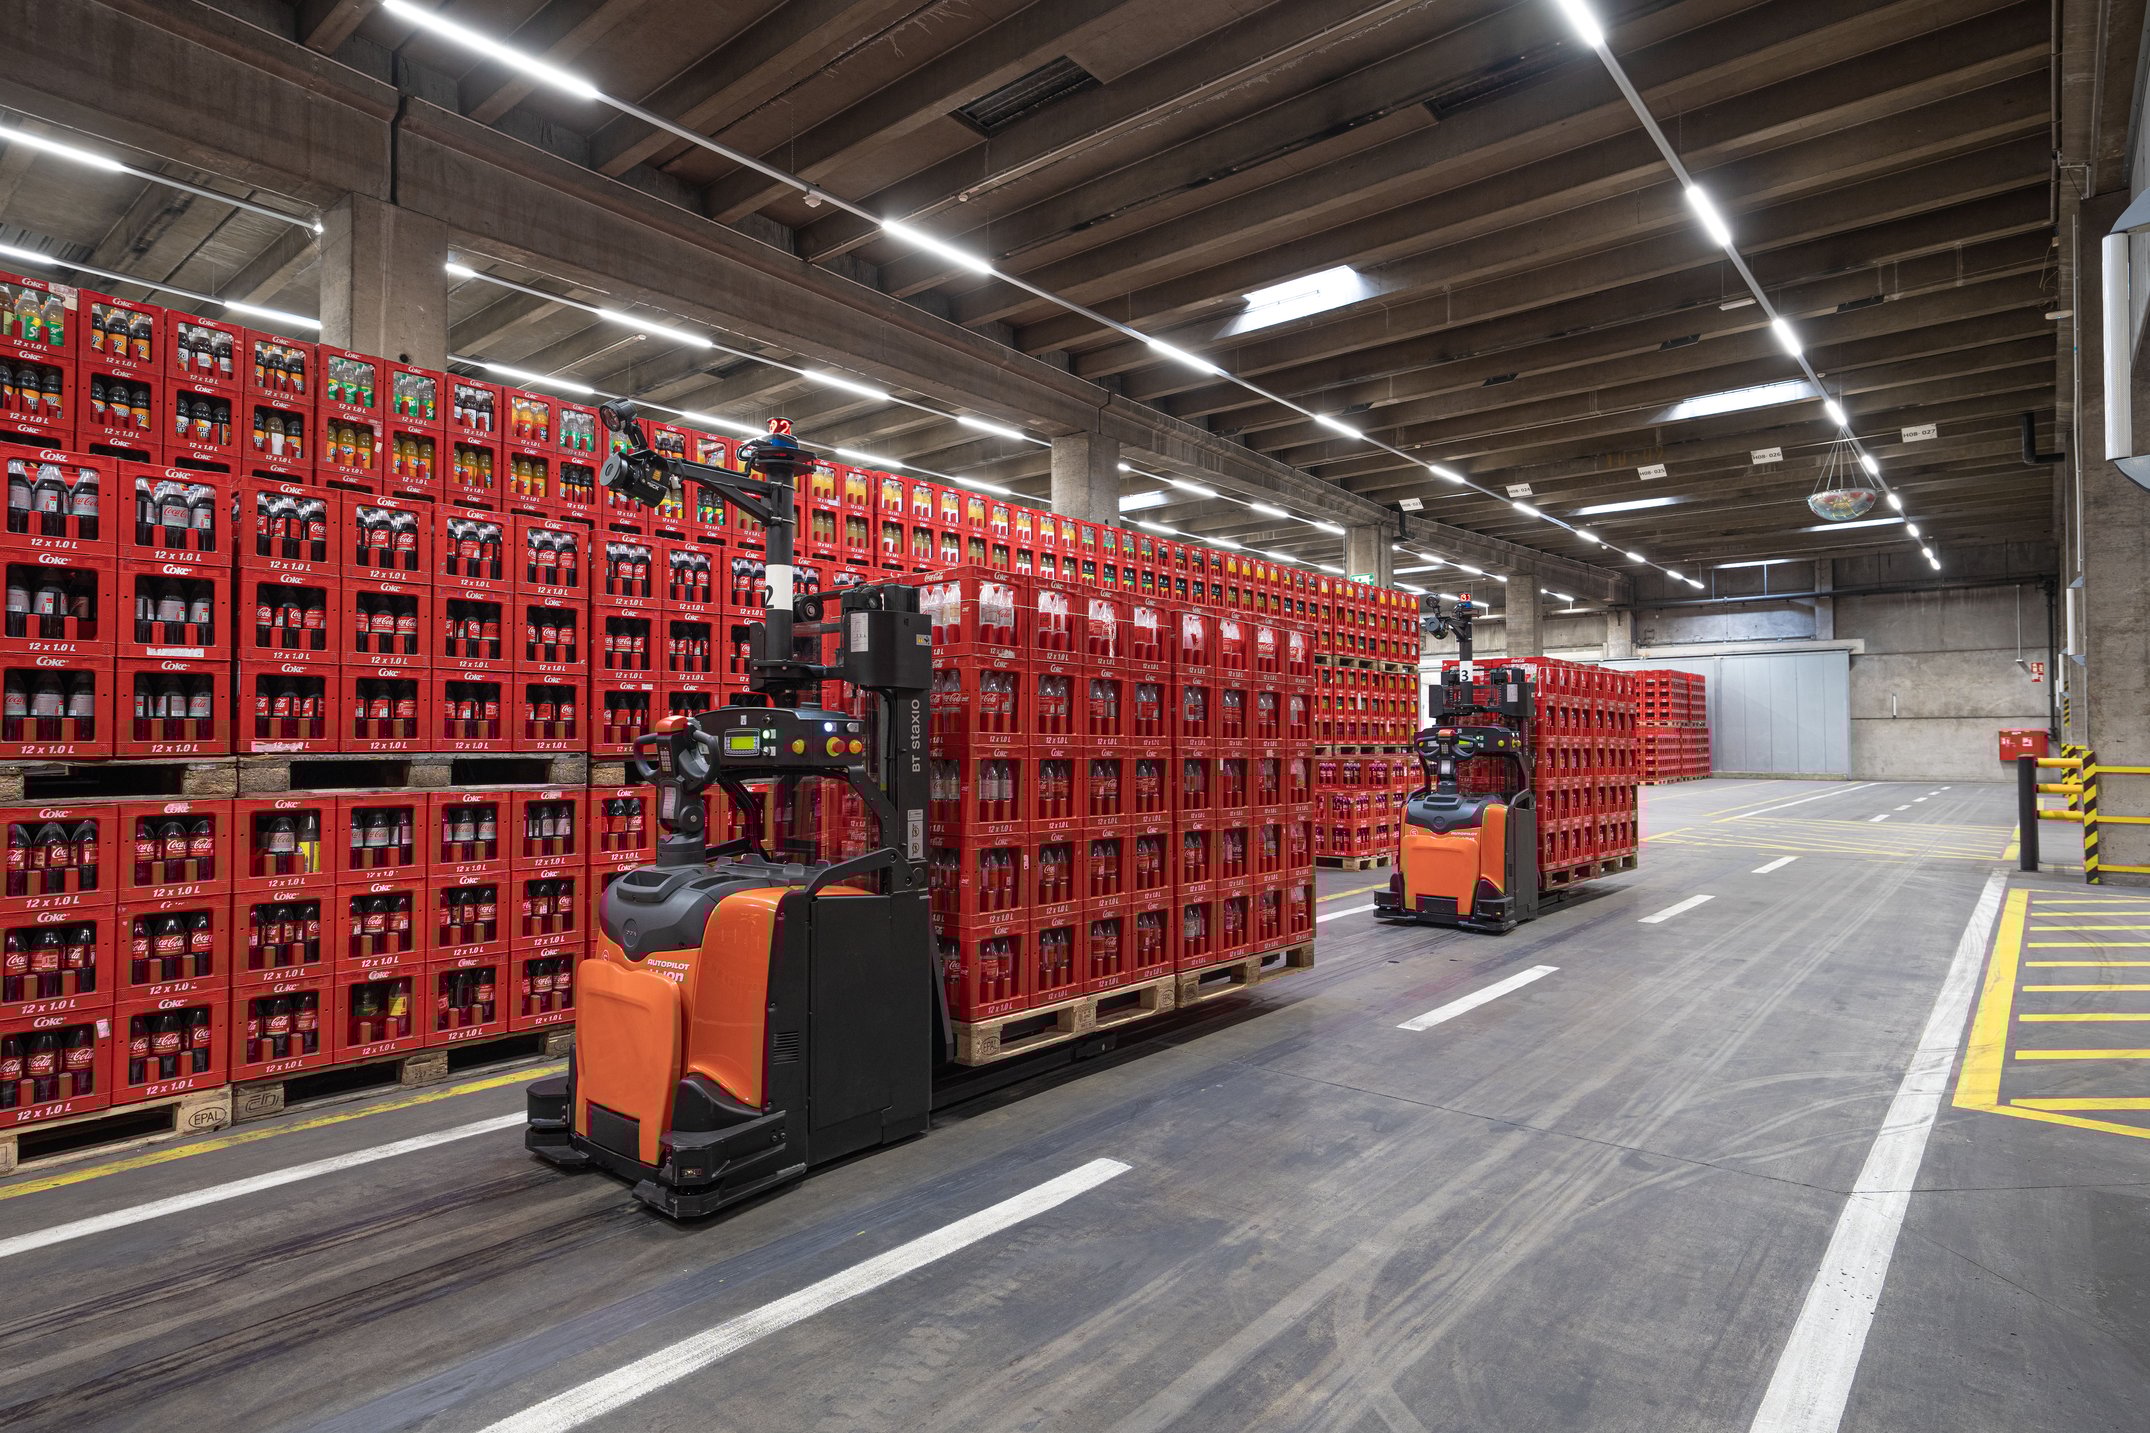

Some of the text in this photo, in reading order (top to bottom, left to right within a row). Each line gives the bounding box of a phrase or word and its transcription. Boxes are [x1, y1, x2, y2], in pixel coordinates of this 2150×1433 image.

[22, 278, 45, 288] Coke
[113, 298, 134, 307] Coke
[198, 318, 218, 327] Coke
[19, 351, 42, 360] Coke
[112, 369, 133, 378] Coke
[195, 385, 214, 393] Coke
[18, 424, 41, 433] Coke
[110, 438, 130, 447] Coke
[40, 450, 68, 462] Coke
[165, 468, 193, 479] Coke
[280, 484, 305, 494] Coke
[377, 497, 399, 507] Coke
[467, 510, 487, 520] Coke
[32, 538, 42, 546] 12
[56, 540, 70, 548] 1.0
[39, 554, 71, 564] Coke
[163, 564, 192, 575] Coke
[280, 574, 303, 584] Coke
[381, 583, 400, 592] Coke
[36, 656, 66, 666] Coke
[162, 661, 190, 670] Coke
[282, 664, 304, 672] Coke
[378, 668, 398, 676] Coke
[464, 672, 484, 680] Coke
[1461, 670, 1469, 681] 3
[911, 699, 920, 772] BT staxio
[22, 746, 34, 754] 12
[176, 744, 190, 752] 1.0
[275, 800, 300, 808] Coke
[40, 808, 69, 818] Coke
[460, 876, 480, 886] Coke
[371, 884, 392, 892] Coke
[27, 899, 40, 908] 12
[55, 896, 70, 905] 1.0
[73, 896, 79, 904] L
[37, 912, 70, 922] Coke
[647, 959, 690, 970] AUTOPILOT
[264, 972, 274, 980] 12
[300, 968, 304, 976] L
[369, 971, 392, 980] Coke
[22, 1004, 35, 1014] 12
[50, 1000, 66, 1010] 1.0
[158, 999, 187, 1009] Coke
[34, 1017, 66, 1027] Coke
[147, 1086, 158, 1095] 12
[172, 1081, 185, 1090] 1.0
[188, 1079, 193, 1087] L
[18, 1103, 71, 1120] 12 x 1.0 L
[194, 1111, 221, 1125] EPAL
